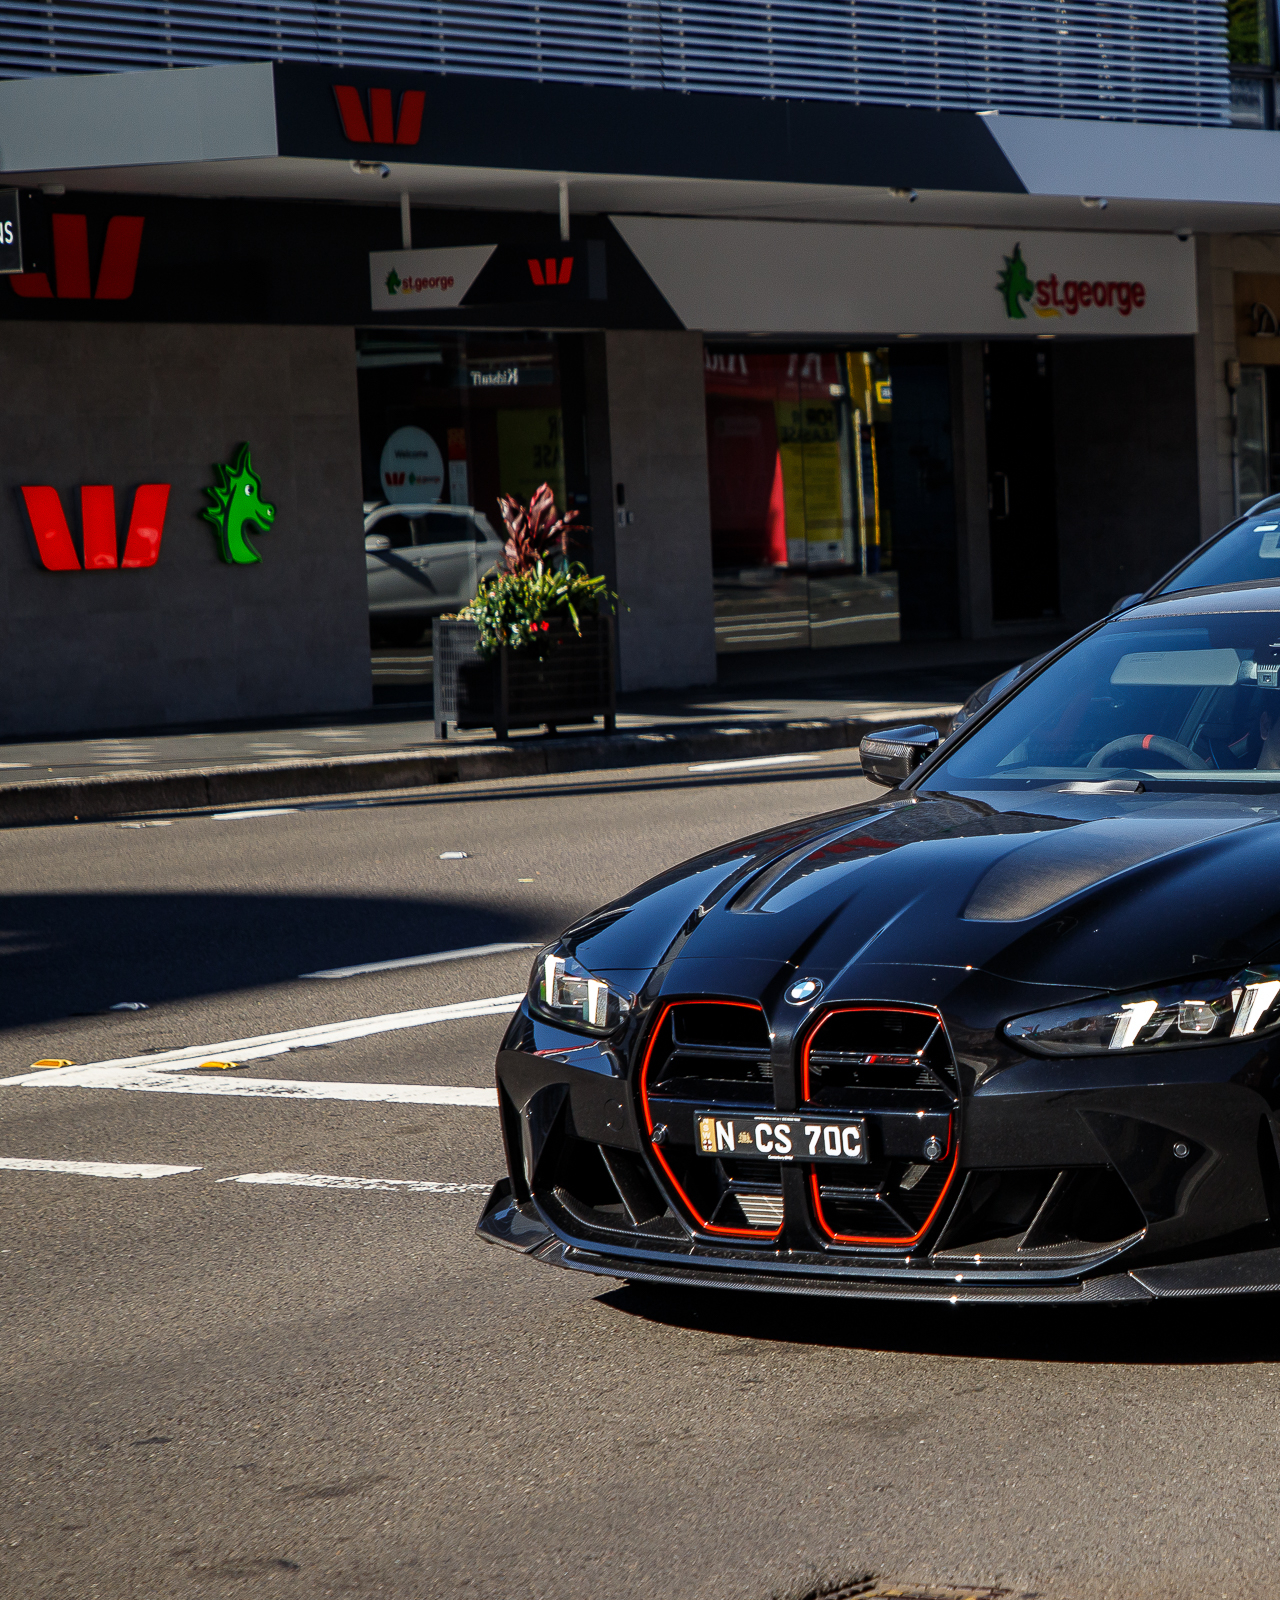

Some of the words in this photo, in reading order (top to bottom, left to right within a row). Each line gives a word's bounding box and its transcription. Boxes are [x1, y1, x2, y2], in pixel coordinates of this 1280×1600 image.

[402, 275, 455, 293] st.george
[1035, 273, 1146, 316] st.george
[715, 1120, 736, 1152] N
[754, 1122, 793, 1154] CS
